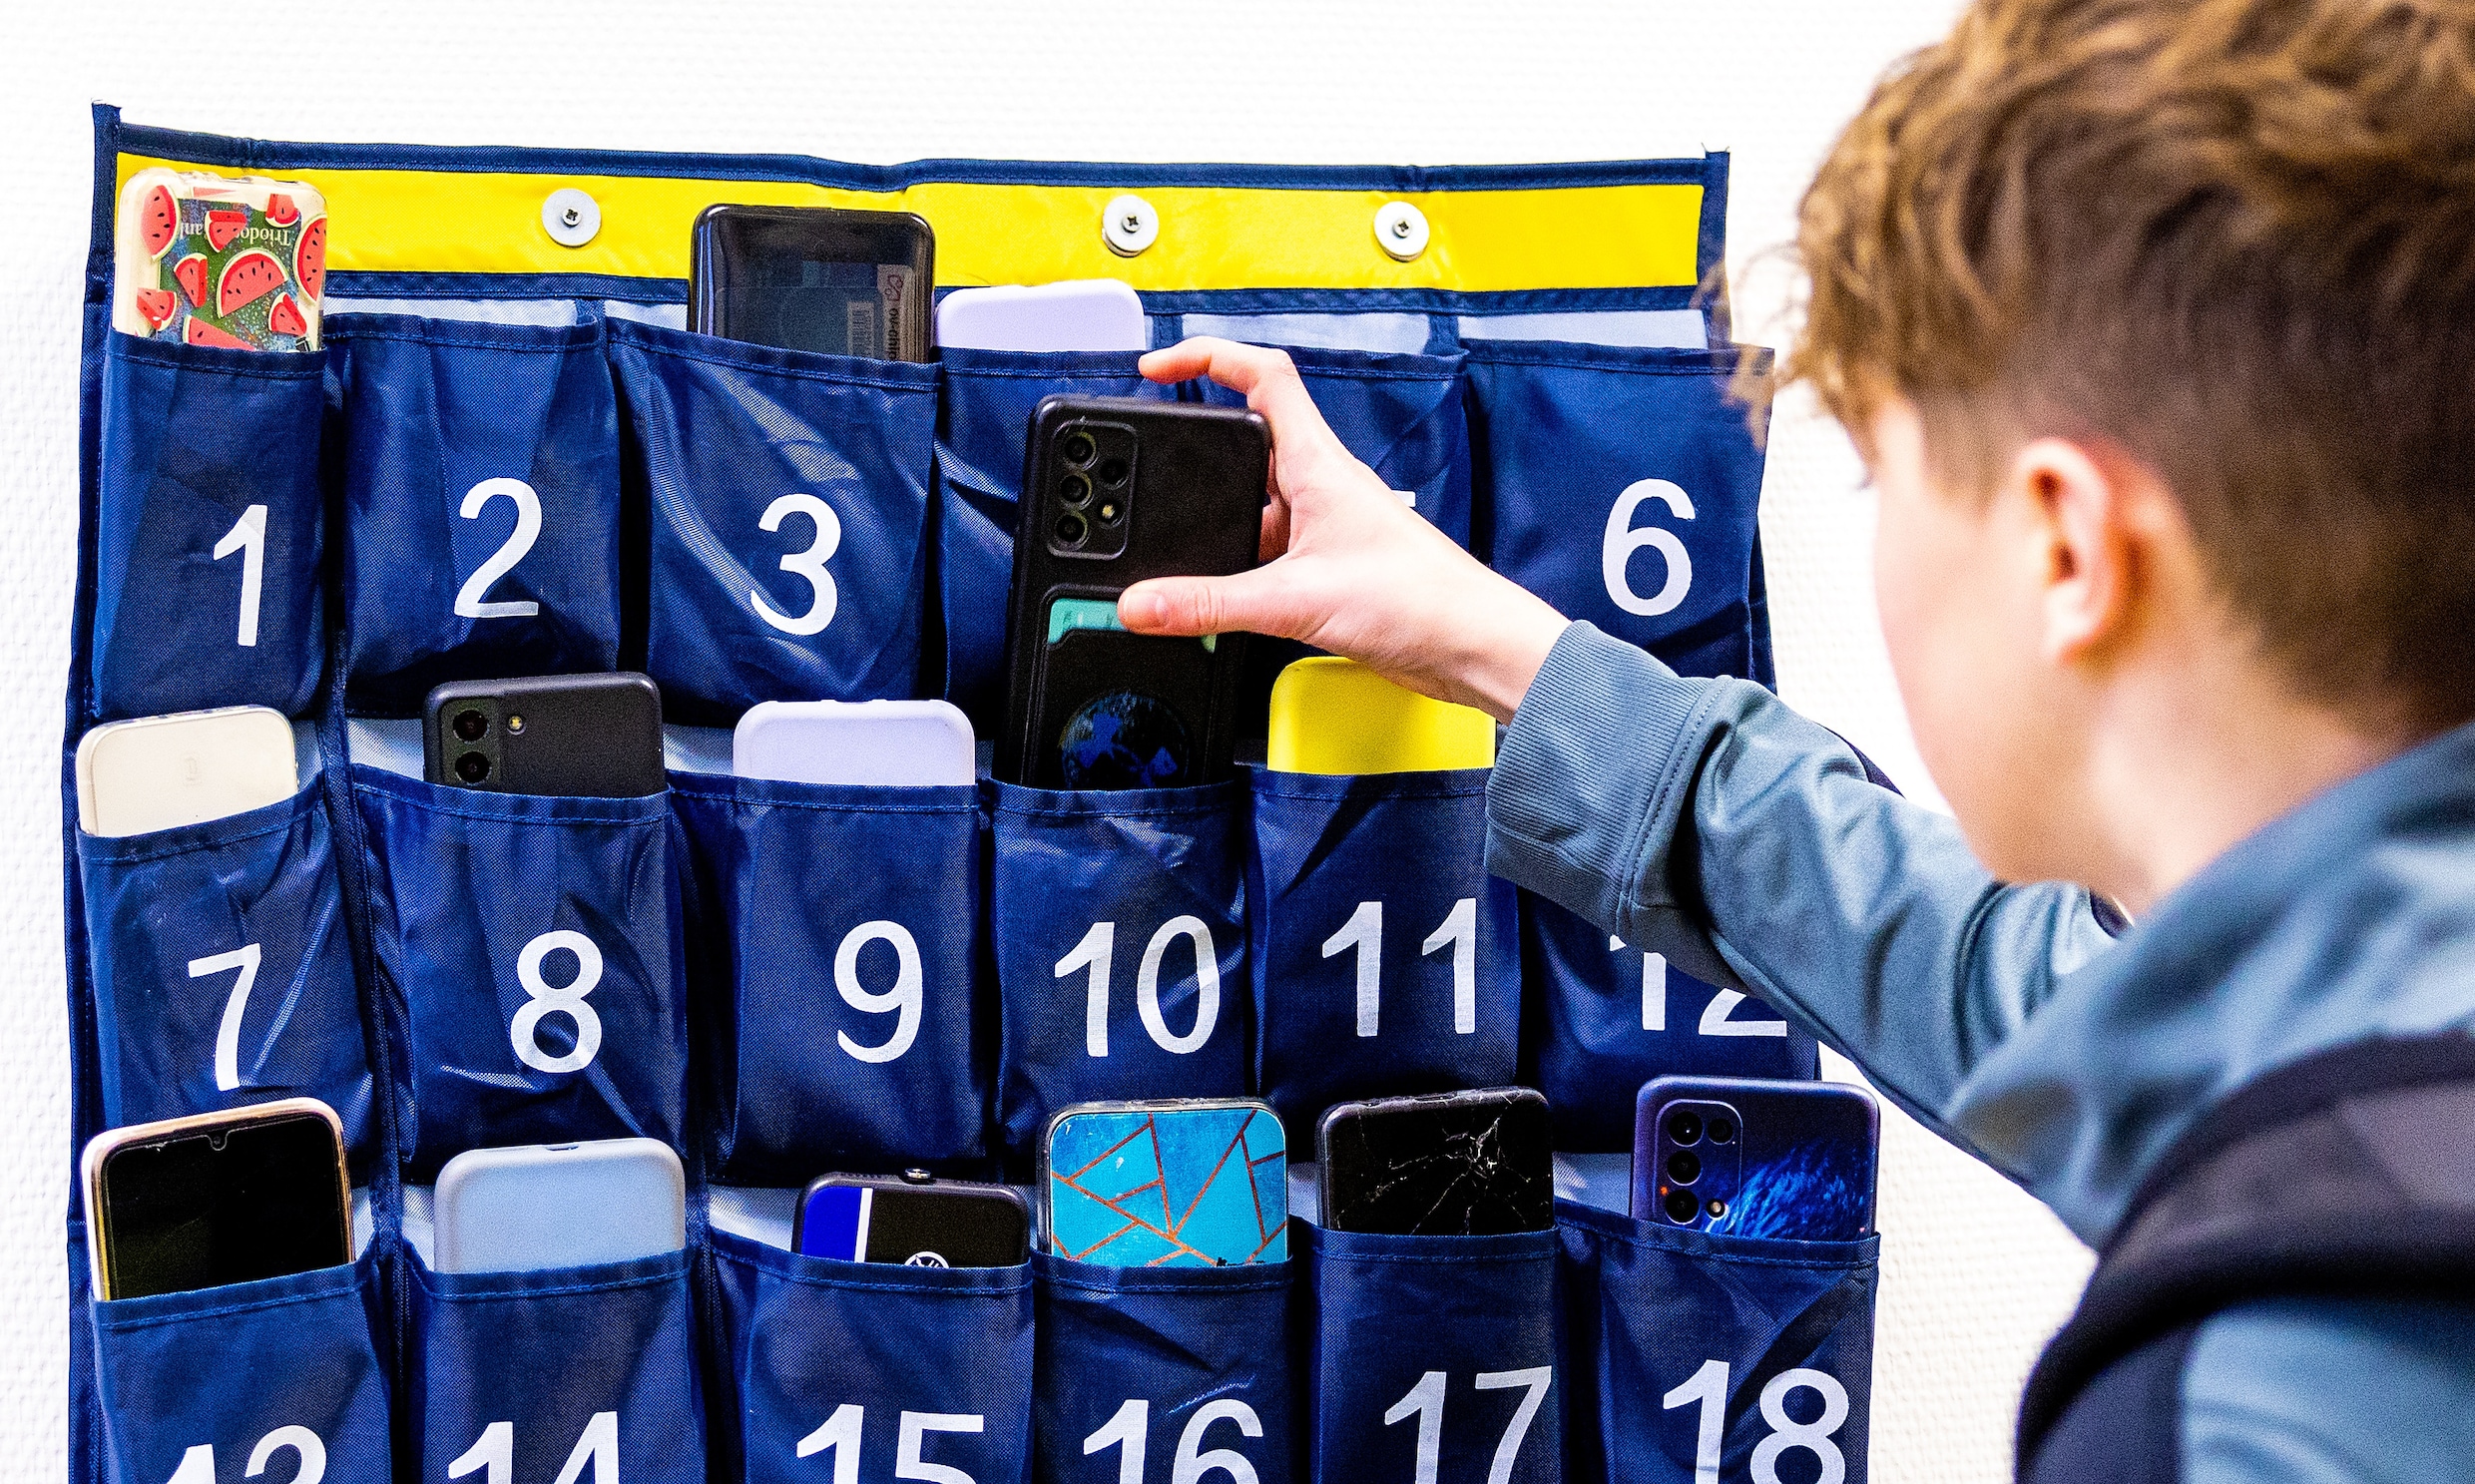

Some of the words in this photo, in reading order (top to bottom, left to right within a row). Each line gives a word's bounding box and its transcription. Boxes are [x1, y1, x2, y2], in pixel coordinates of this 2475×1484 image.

[213, 504, 268, 648] 1
[453, 476, 544, 619] 2
[749, 492, 841, 637] 3
[1601, 477, 1697, 617] 6
[187, 941, 262, 1093] 7
[509, 929, 604, 1075] 8
[833, 920, 924, 1064] 9
[1053, 913, 1222, 1059] 10
[1320, 896, 1478, 1039] 11
[795, 1403, 984, 1484] 15
[1083, 1398, 1264, 1484] 16
[1384, 1365, 1553, 1484] 17
[1662, 1358, 1850, 1484] 18
